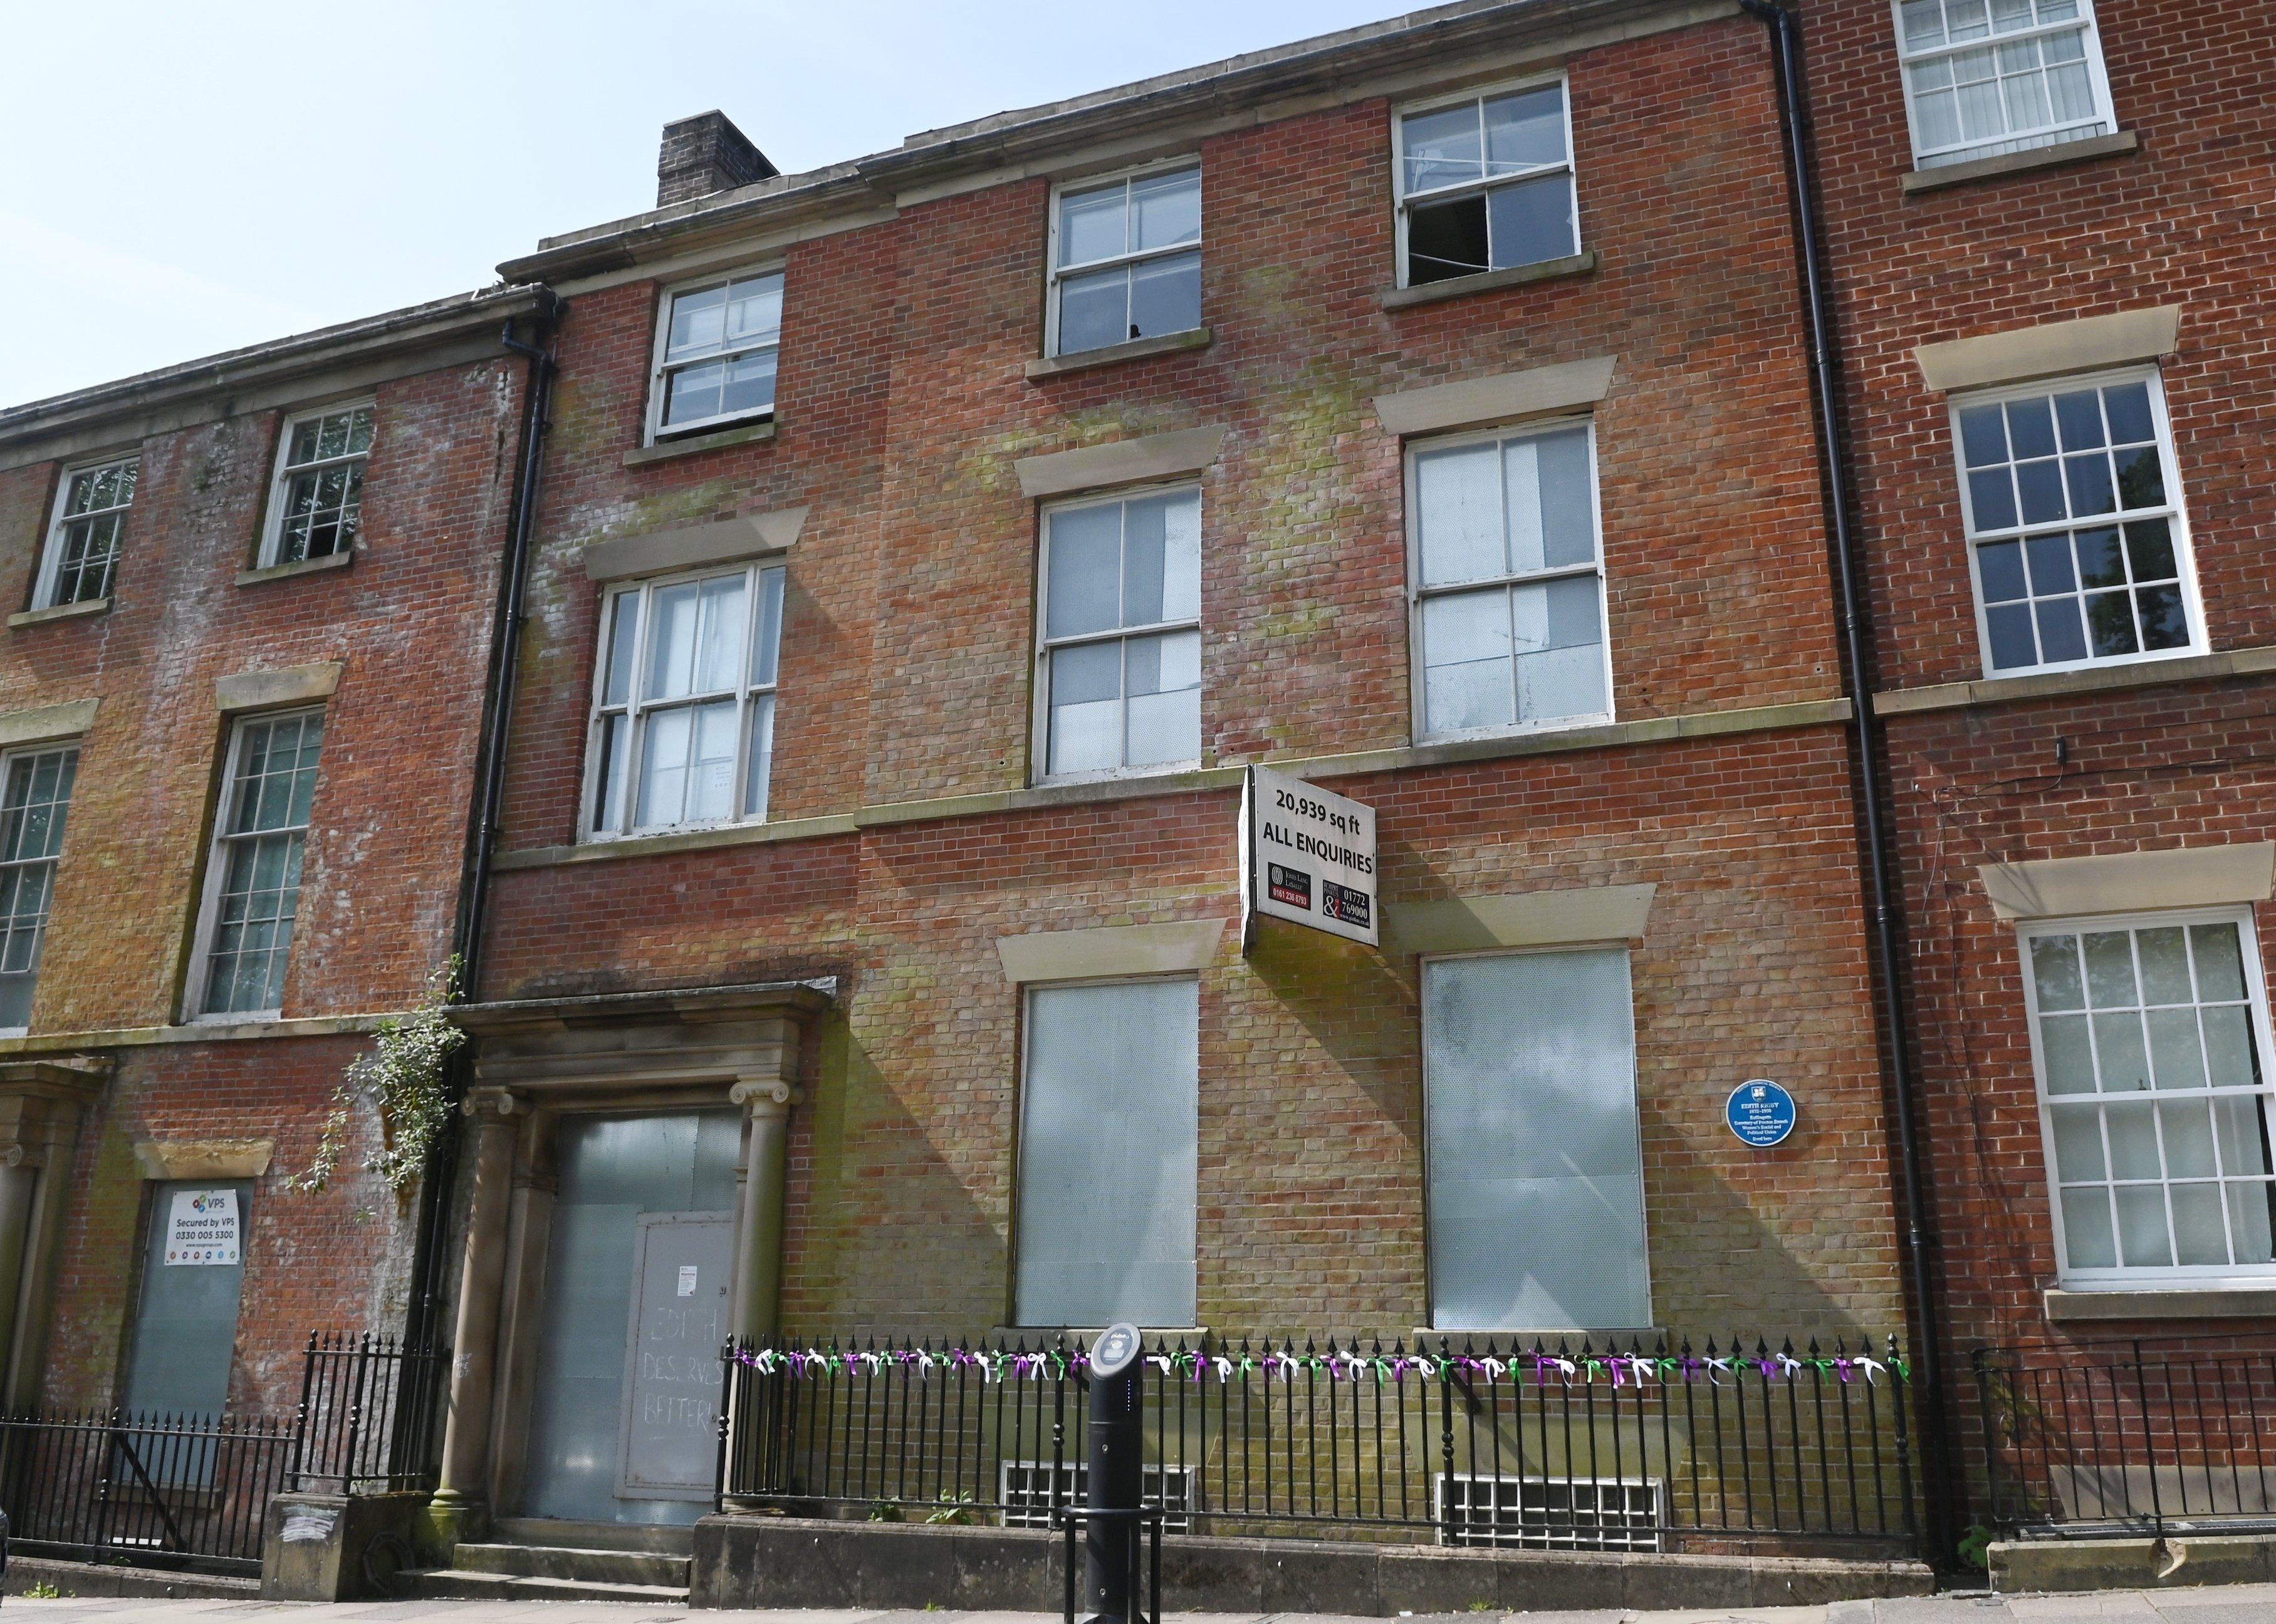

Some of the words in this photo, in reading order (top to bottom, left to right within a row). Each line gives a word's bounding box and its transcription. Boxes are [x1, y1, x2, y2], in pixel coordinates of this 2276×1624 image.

[1276, 789, 1326, 821] 20,939
[1330, 813, 1345, 834] sq
[1349, 815, 1360, 835] ft
[1263, 821, 1293, 847] ALL
[1297, 832, 1372, 875] ENQUIRIES
[1273, 887, 1285, 898] 0161
[1344, 889, 1365, 905] 01772
[1323, 895, 1338, 918] &
[1342, 901, 1367, 919] 769000
[207, 1197, 225, 1209] VPS
[176, 1218, 208, 1227] Secured
[210, 1218, 219, 1228] by
[222, 1217, 235, 1226] VPS
[175, 1231, 196, 1240] 0330
[198, 1231, 213, 1239] 005
[215, 1231, 234, 1239] 5300
[651, 1306, 717, 1343] EDIH
[643, 1352, 724, 1385] DESRVES
